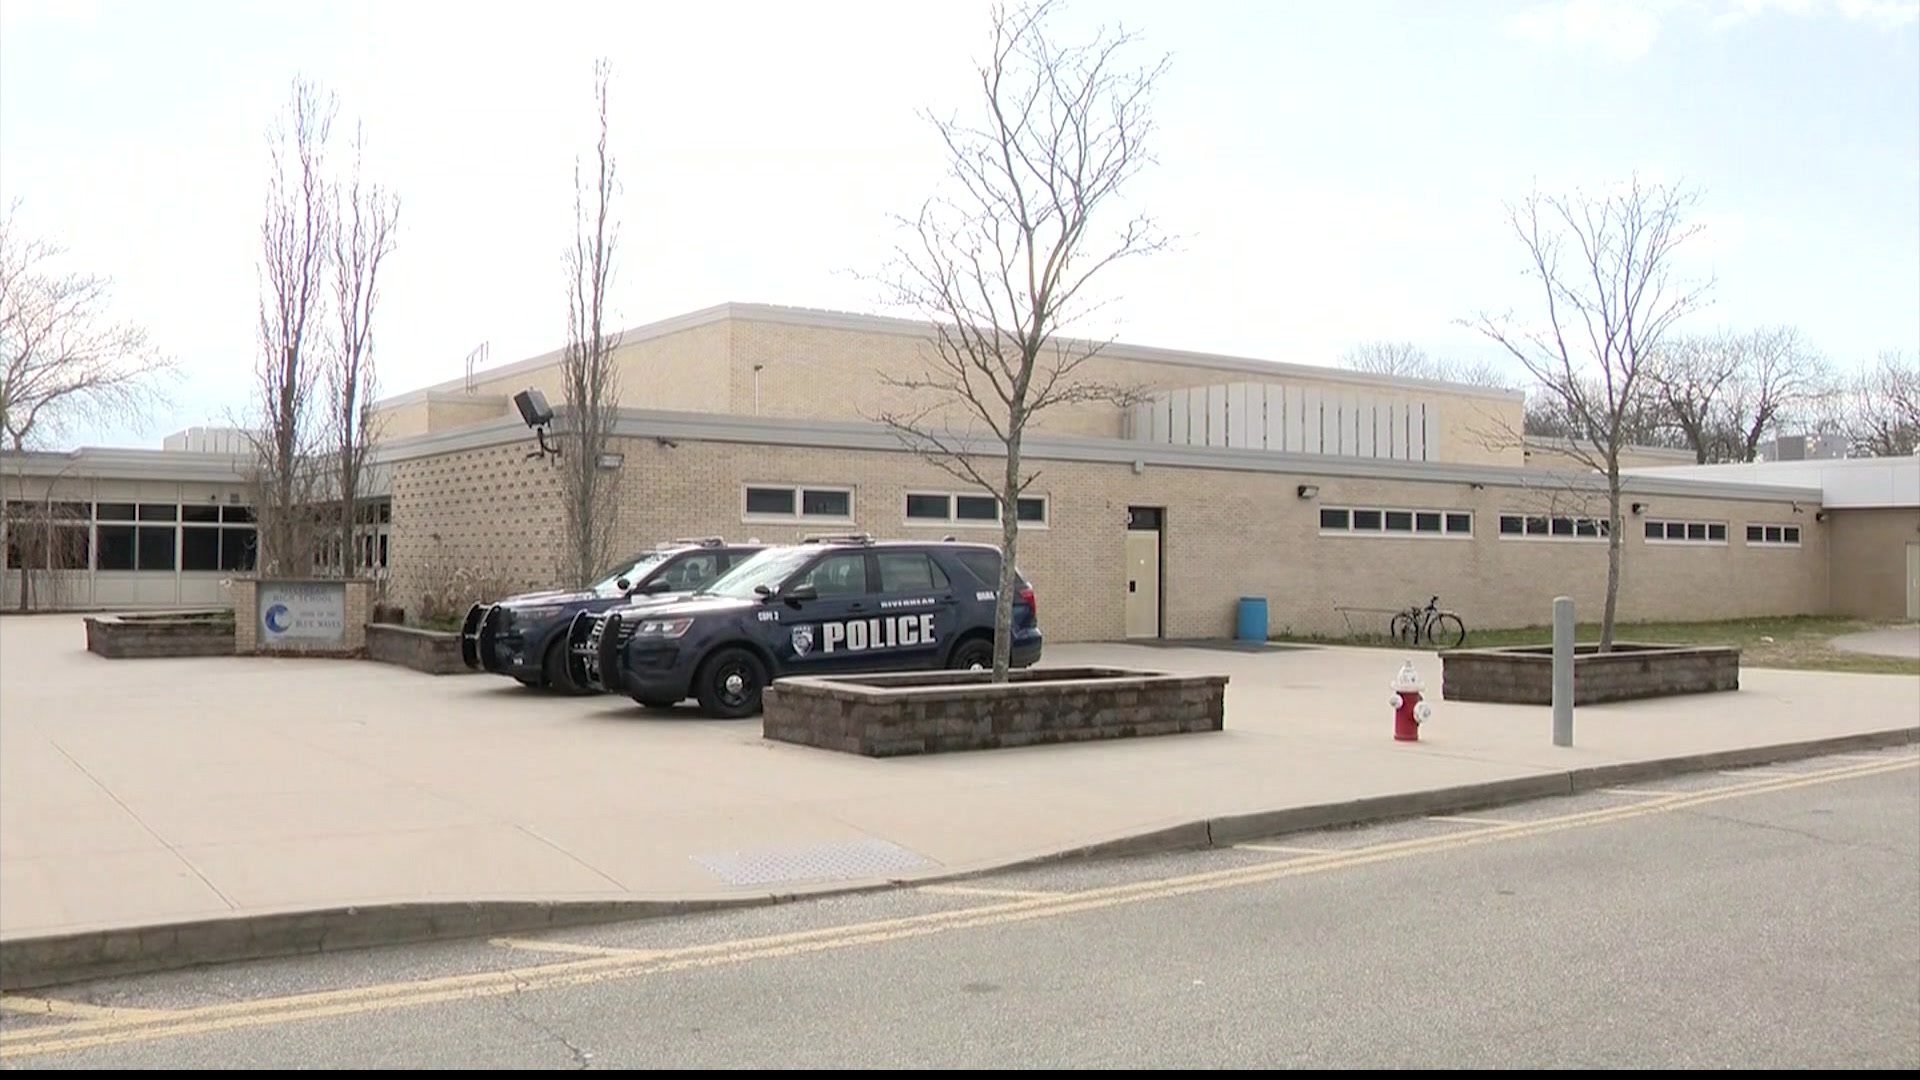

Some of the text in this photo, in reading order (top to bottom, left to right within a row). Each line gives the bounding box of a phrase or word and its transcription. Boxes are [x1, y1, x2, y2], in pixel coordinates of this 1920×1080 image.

[880, 598, 936, 608] RIVERHEAD
[318, 621, 341, 629] WAVES
[822, 614, 936, 653] POLICE
